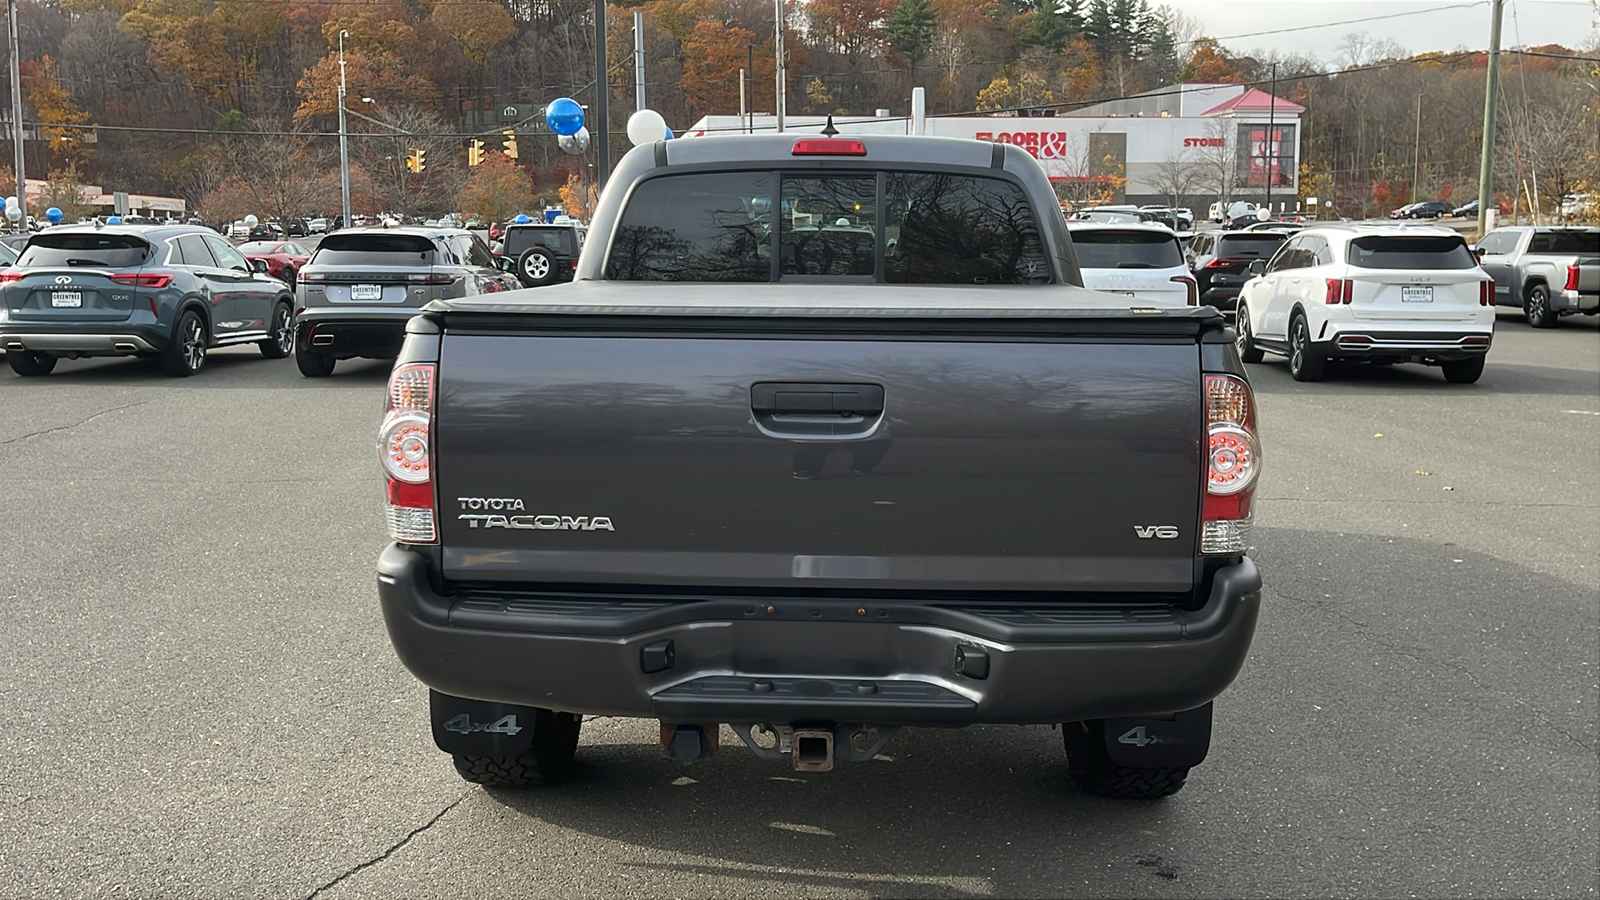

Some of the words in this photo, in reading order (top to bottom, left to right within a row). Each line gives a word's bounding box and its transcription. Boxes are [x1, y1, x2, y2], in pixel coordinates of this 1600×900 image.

[1183, 138, 1225, 147] STONE
[458, 497, 525, 511] TOYOTA
[458, 514, 615, 531] TACOMA
[1133, 525, 1179, 539] V6
